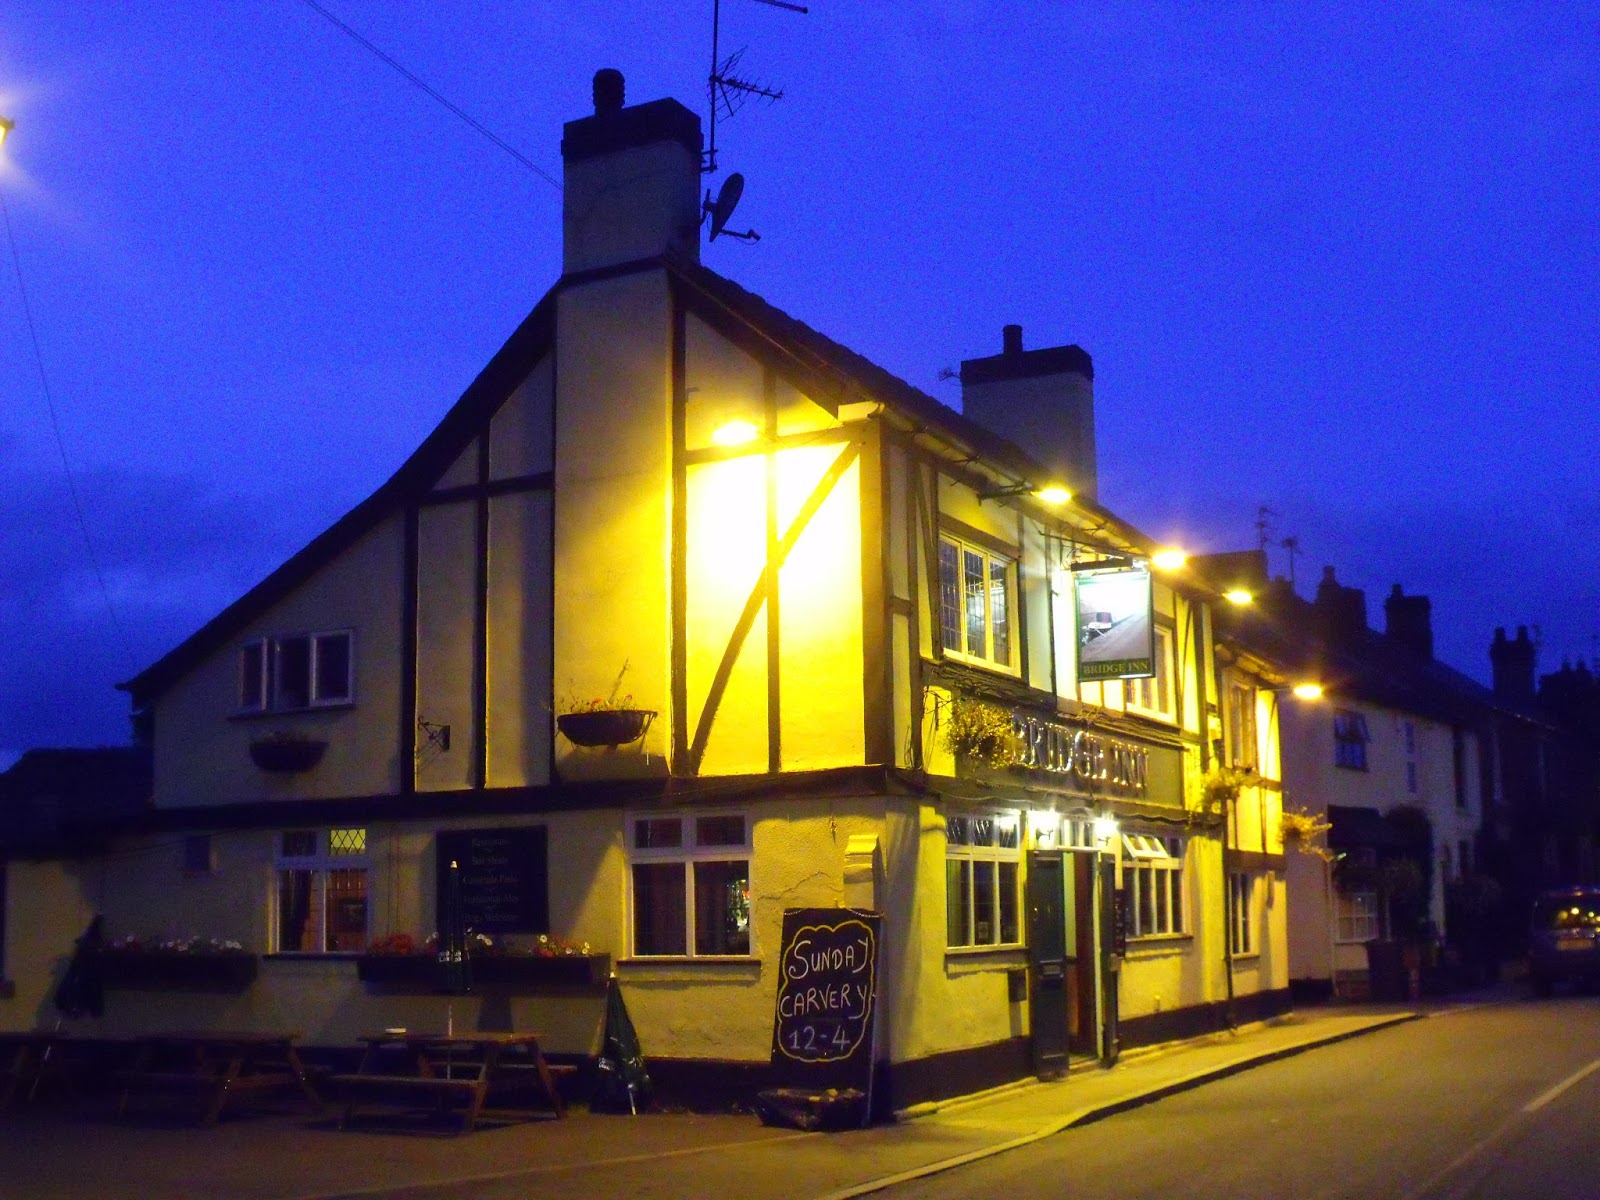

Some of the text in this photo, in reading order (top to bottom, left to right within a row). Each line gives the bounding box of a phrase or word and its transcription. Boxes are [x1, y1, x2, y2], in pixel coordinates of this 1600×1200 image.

[1083, 661, 1149, 674] BRIDGE INN
[788, 937, 869, 980] SUNDAY
[780, 983, 868, 1020] CARVERY
